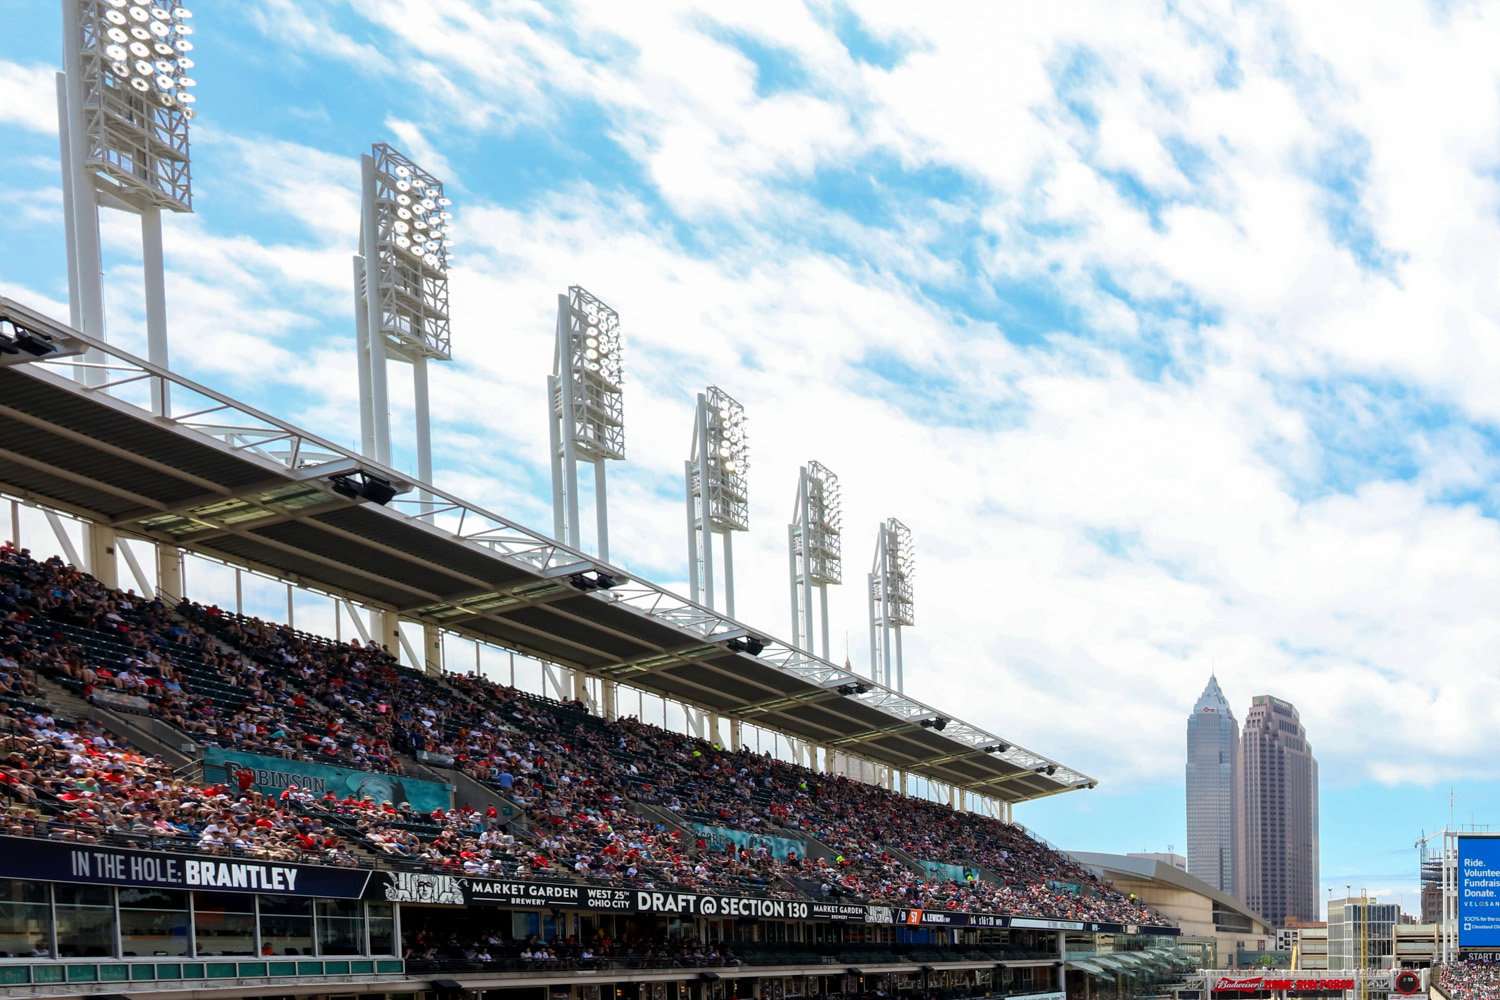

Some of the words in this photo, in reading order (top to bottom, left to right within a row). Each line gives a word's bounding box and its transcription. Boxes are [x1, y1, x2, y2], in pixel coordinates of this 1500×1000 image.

[1464, 859, 1486, 867] Ride.
[72, 851, 90, 877] IN
[94, 853, 125, 879] THE
[131, 857, 182, 883] HOLE:
[186, 861, 297, 891] BRANTLEY
[472, 882, 524, 895] MARKET
[529, 886, 578, 898] GARDEN
[588, 888, 612, 898] WEST
[1464, 889, 1497, 897] Donate.
[511, 897, 546, 906] BREWERY
[588, 899, 611, 908] OHIO
[612, 900, 630, 909] CITY
[638, 892, 696, 913] DRAFT
[700, 896, 717, 916] @
[721, 898, 784, 918] SECTION
[787, 902, 808, 918] 130
[814, 904, 838, 913] MARKET
[840, 906, 863, 915] GARDEN
[911, 910, 918, 923] 57
[1468, 952, 1492, 961] START
[1217, 980, 1259, 989] Budweiser
